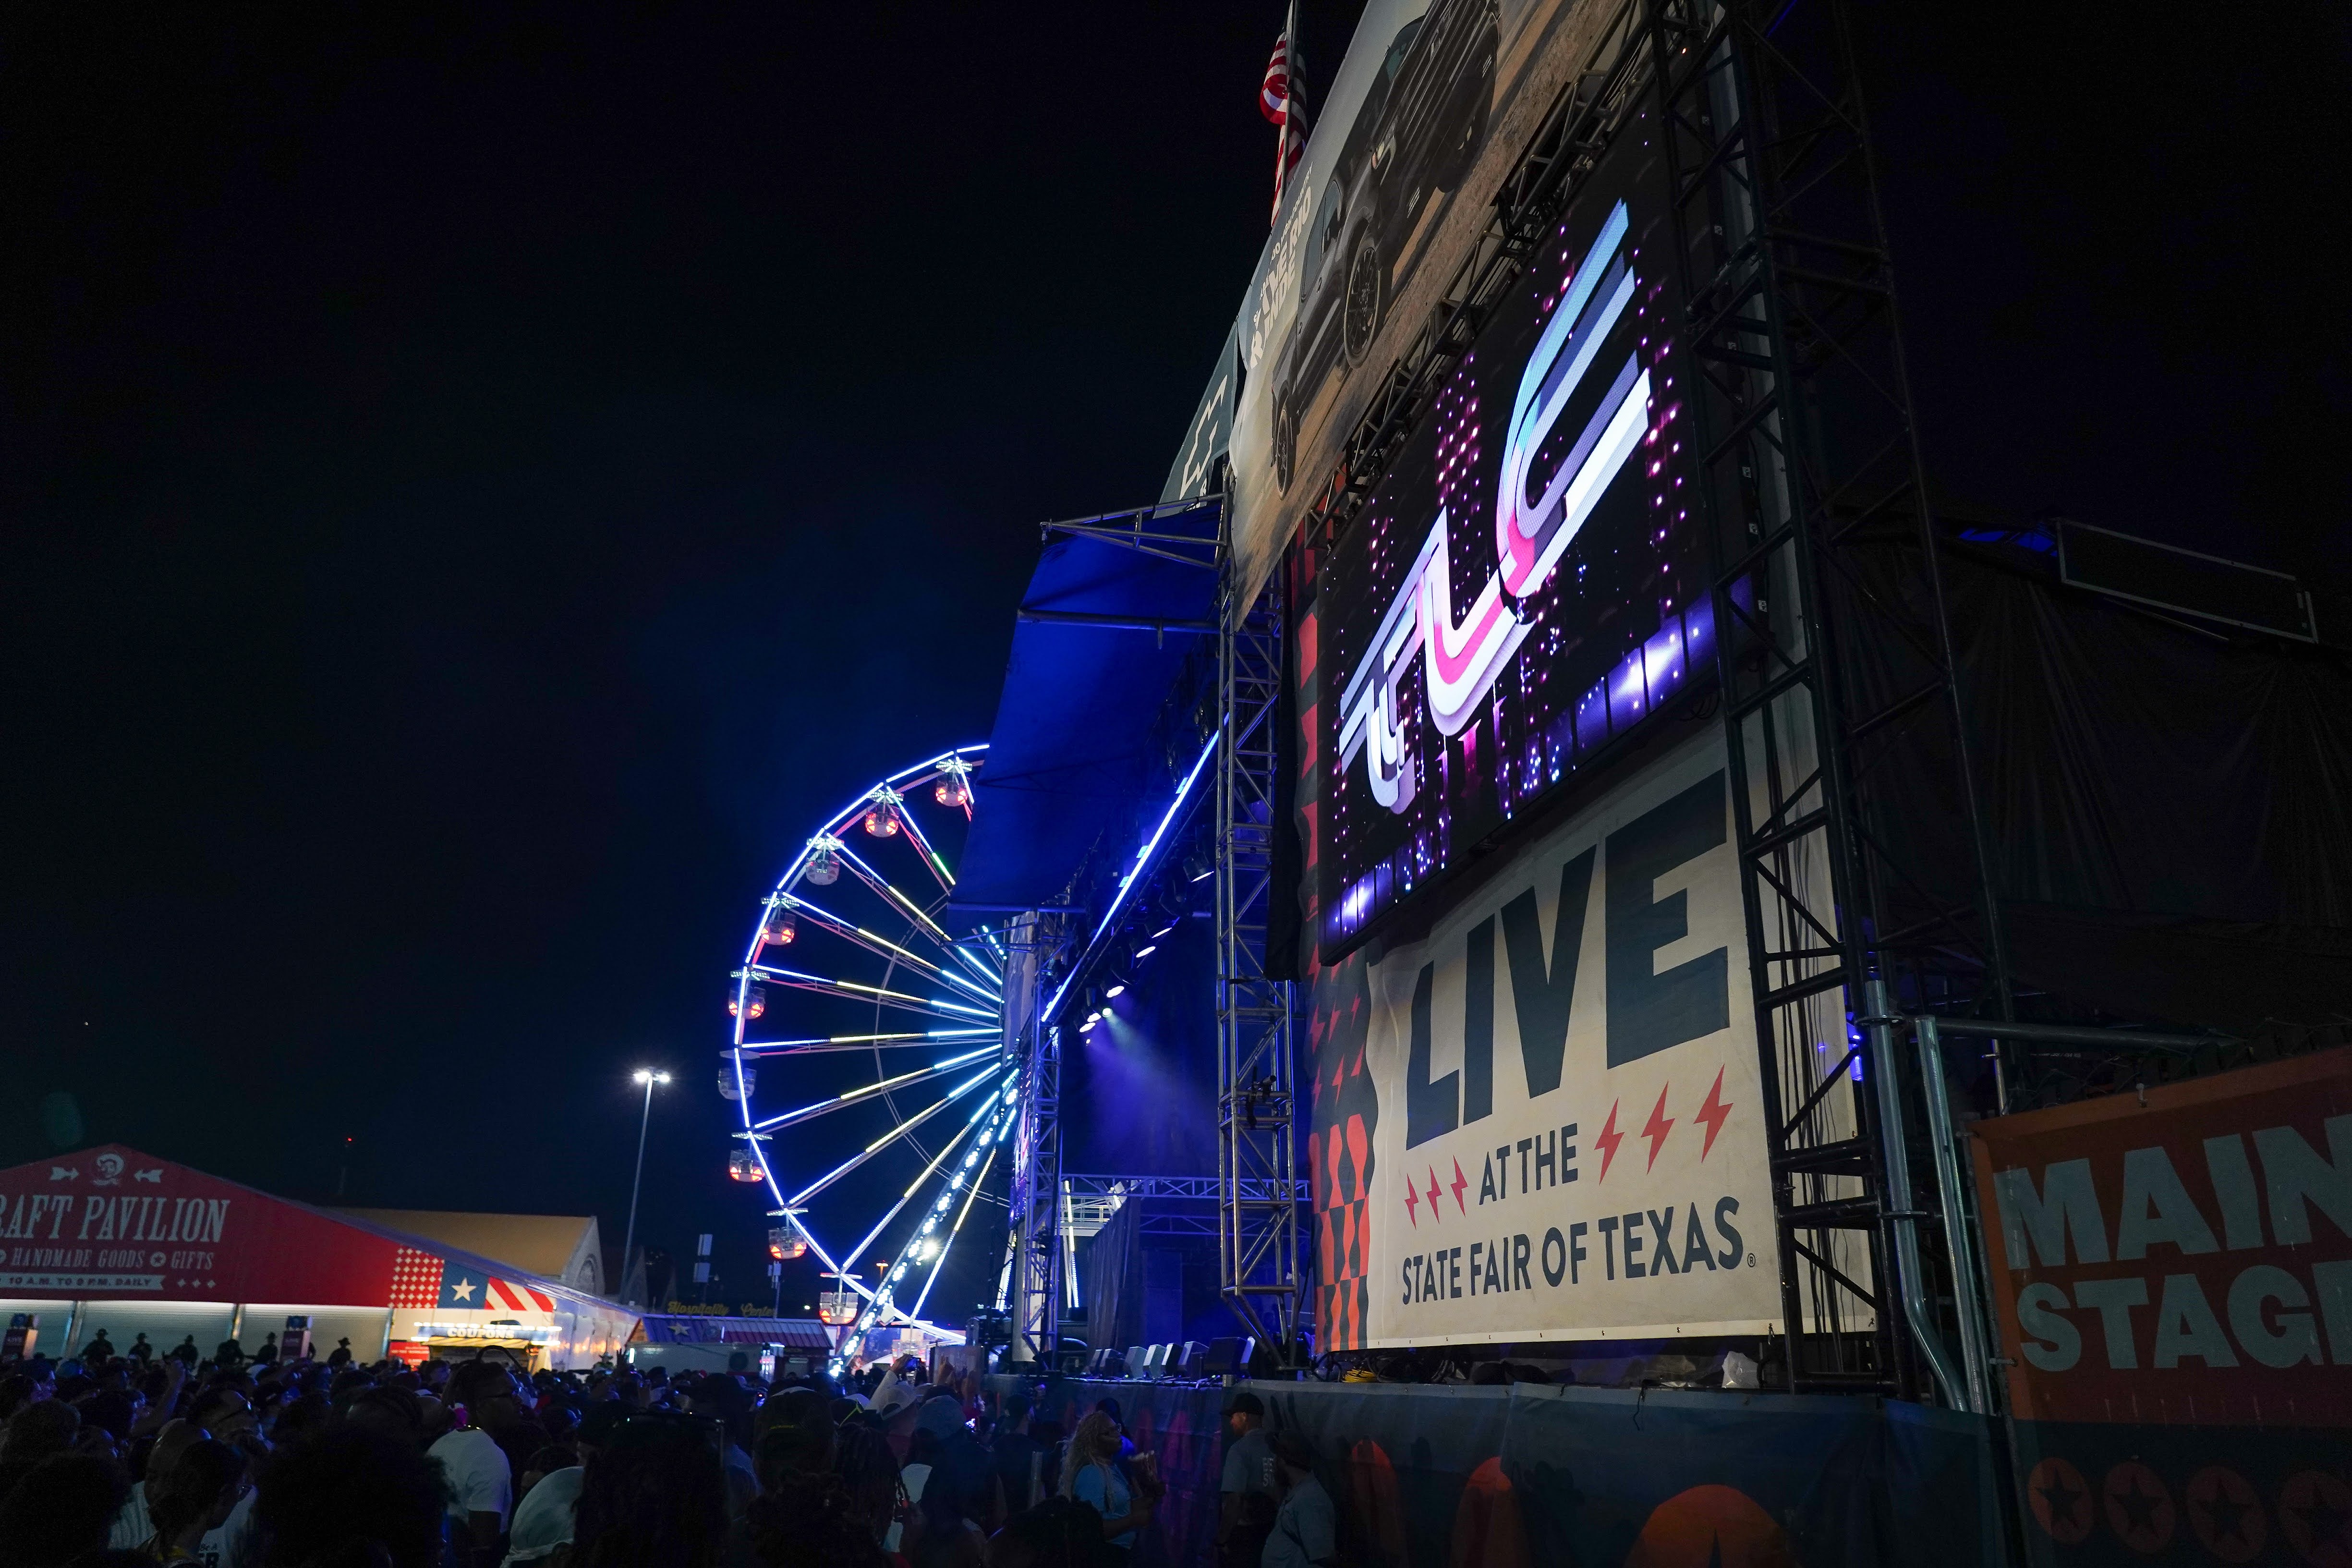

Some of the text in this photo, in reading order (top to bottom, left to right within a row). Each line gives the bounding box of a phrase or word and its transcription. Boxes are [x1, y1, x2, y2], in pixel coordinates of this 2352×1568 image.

[1291, 161, 1313, 219] COUNTRY
[1289, 186, 1311, 259] RIO
[1406, 767, 1731, 1151] LIVE
[1479, 1123, 1578, 1205] AT THE
[1993, 1113, 2352, 1271] MAIN
[77, 1196, 231, 1243] PAVILION
[10, 1248, 216, 1270] HANDMADE GOODS GIFTS
[57, 1277, 73, 1286] TO
[115, 1277, 152, 1286] DAILY
[1402, 1247, 1462, 1305] STATE
[1470, 1234, 1532, 1296] FAIR
[1541, 1222, 1588, 1288] OF
[447, 1327, 515, 1339] COUPONS
[667, 1301, 730, 1316] Hospitality
